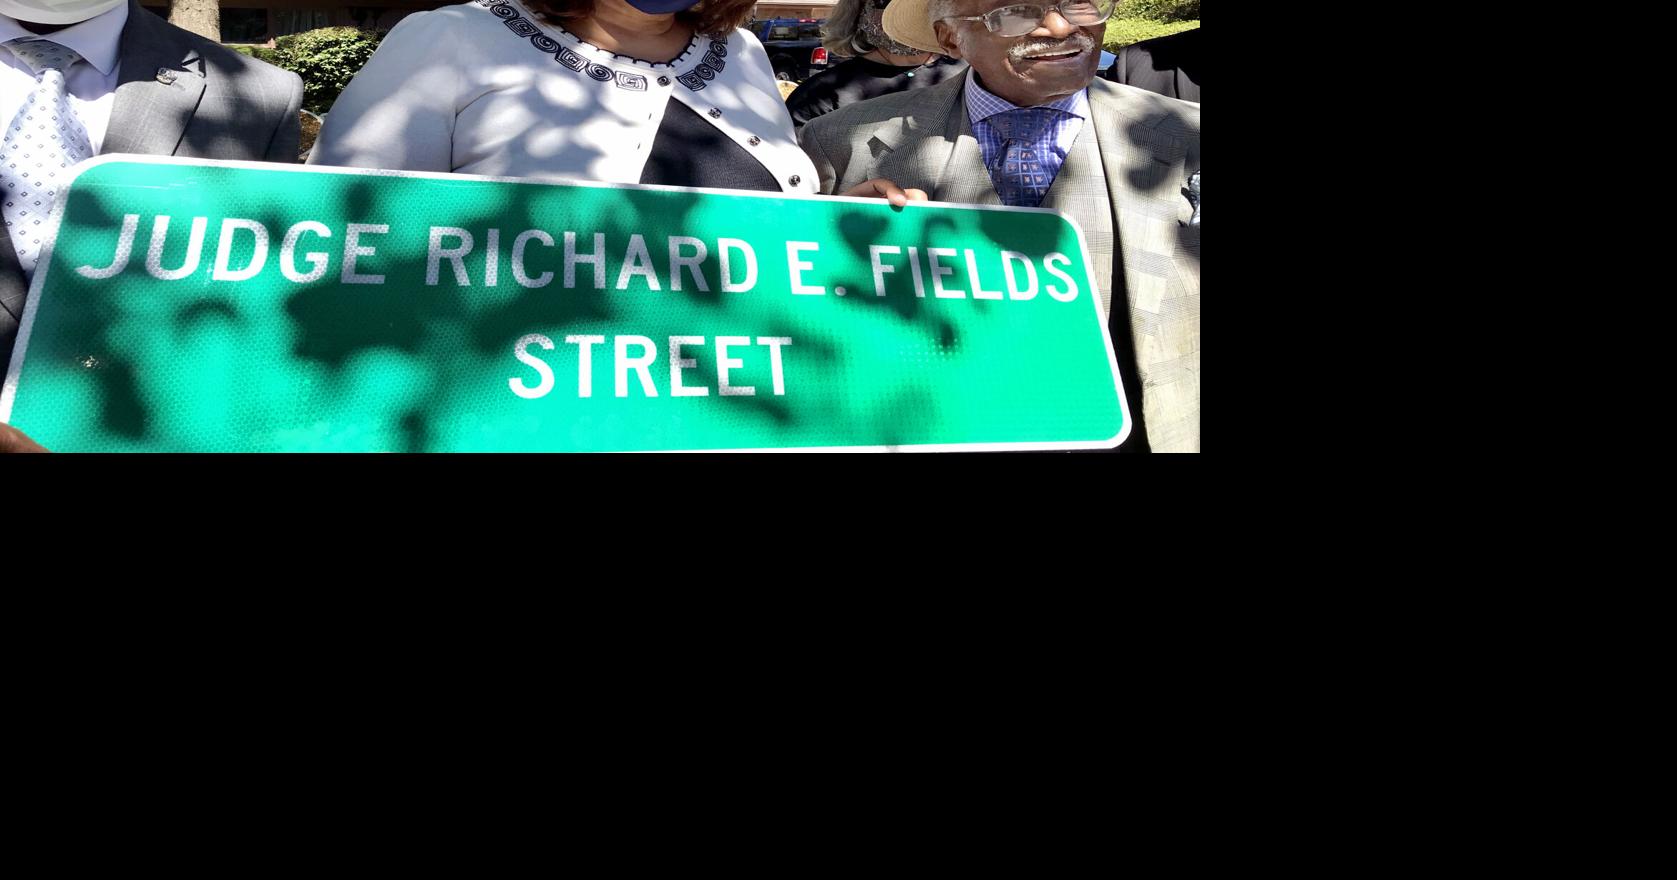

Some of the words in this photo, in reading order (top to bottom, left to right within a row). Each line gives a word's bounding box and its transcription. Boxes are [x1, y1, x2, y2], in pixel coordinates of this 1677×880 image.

[76, 213, 390, 285] JUDGE
[425, 225, 759, 294] RICHARD
[786, 240, 847, 297] E.
[868, 244, 1079, 303] FIELDS
[508, 333, 793, 399] STREET
